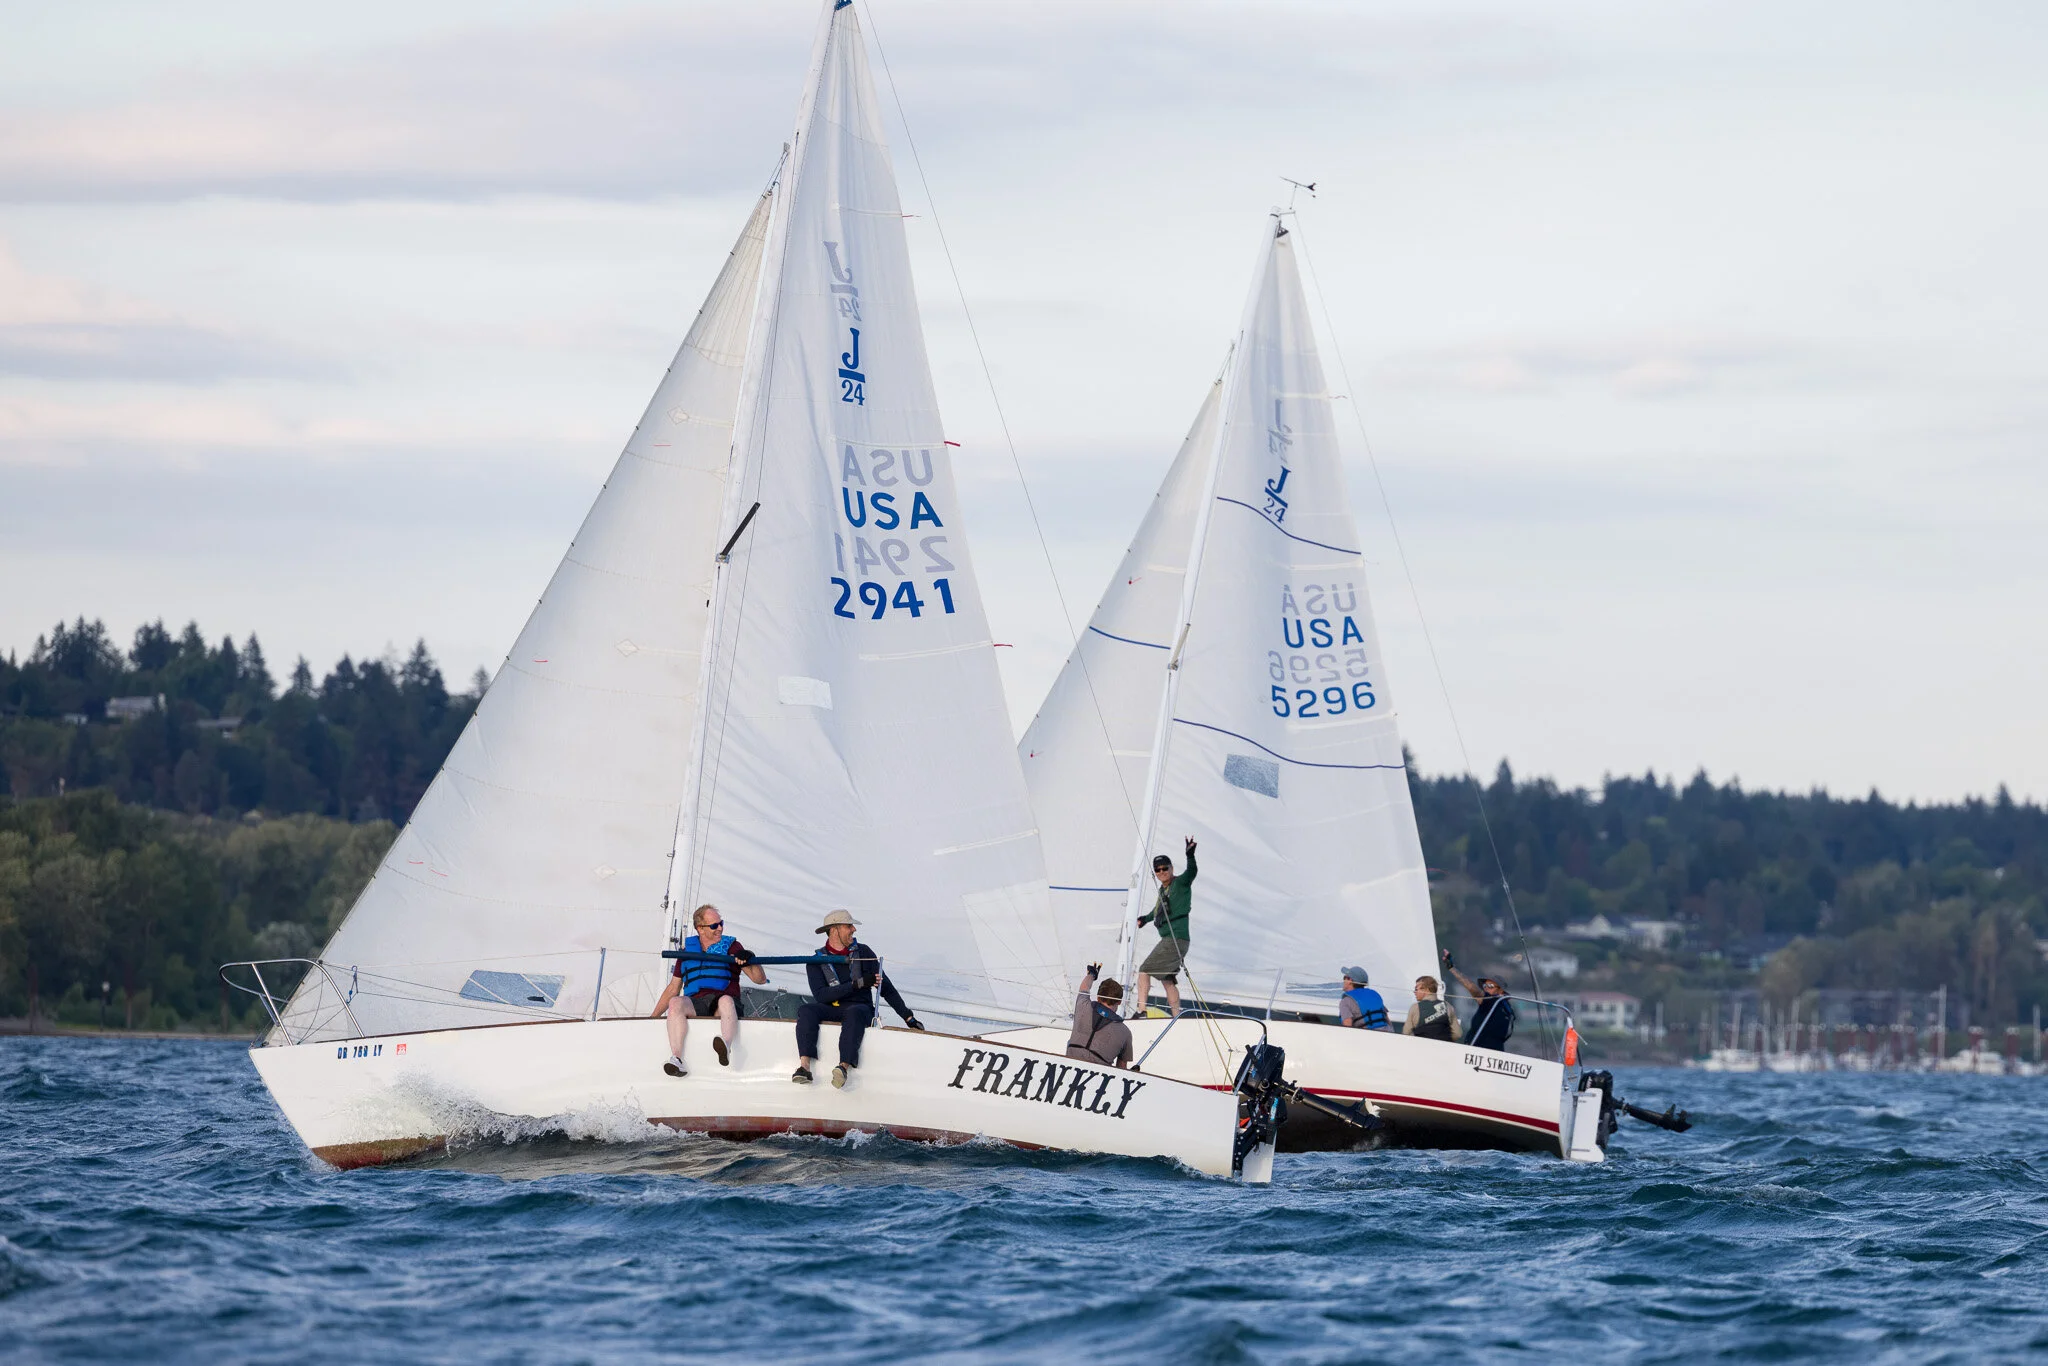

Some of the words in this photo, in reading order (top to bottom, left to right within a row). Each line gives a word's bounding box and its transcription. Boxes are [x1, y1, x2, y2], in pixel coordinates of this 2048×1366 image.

[841, 379, 865, 406] 24
[842, 486, 944, 530] USA
[1263, 497, 1286, 524] 24
[831, 576, 955, 620] 2941
[1282, 616, 1364, 649] USA
[1271, 681, 1376, 718] 5296
[1464, 1053, 1484, 1066] EXIT
[1487, 1057, 1533, 1077] STRATEGY
[947, 1048, 1147, 1120] FRANKLY
